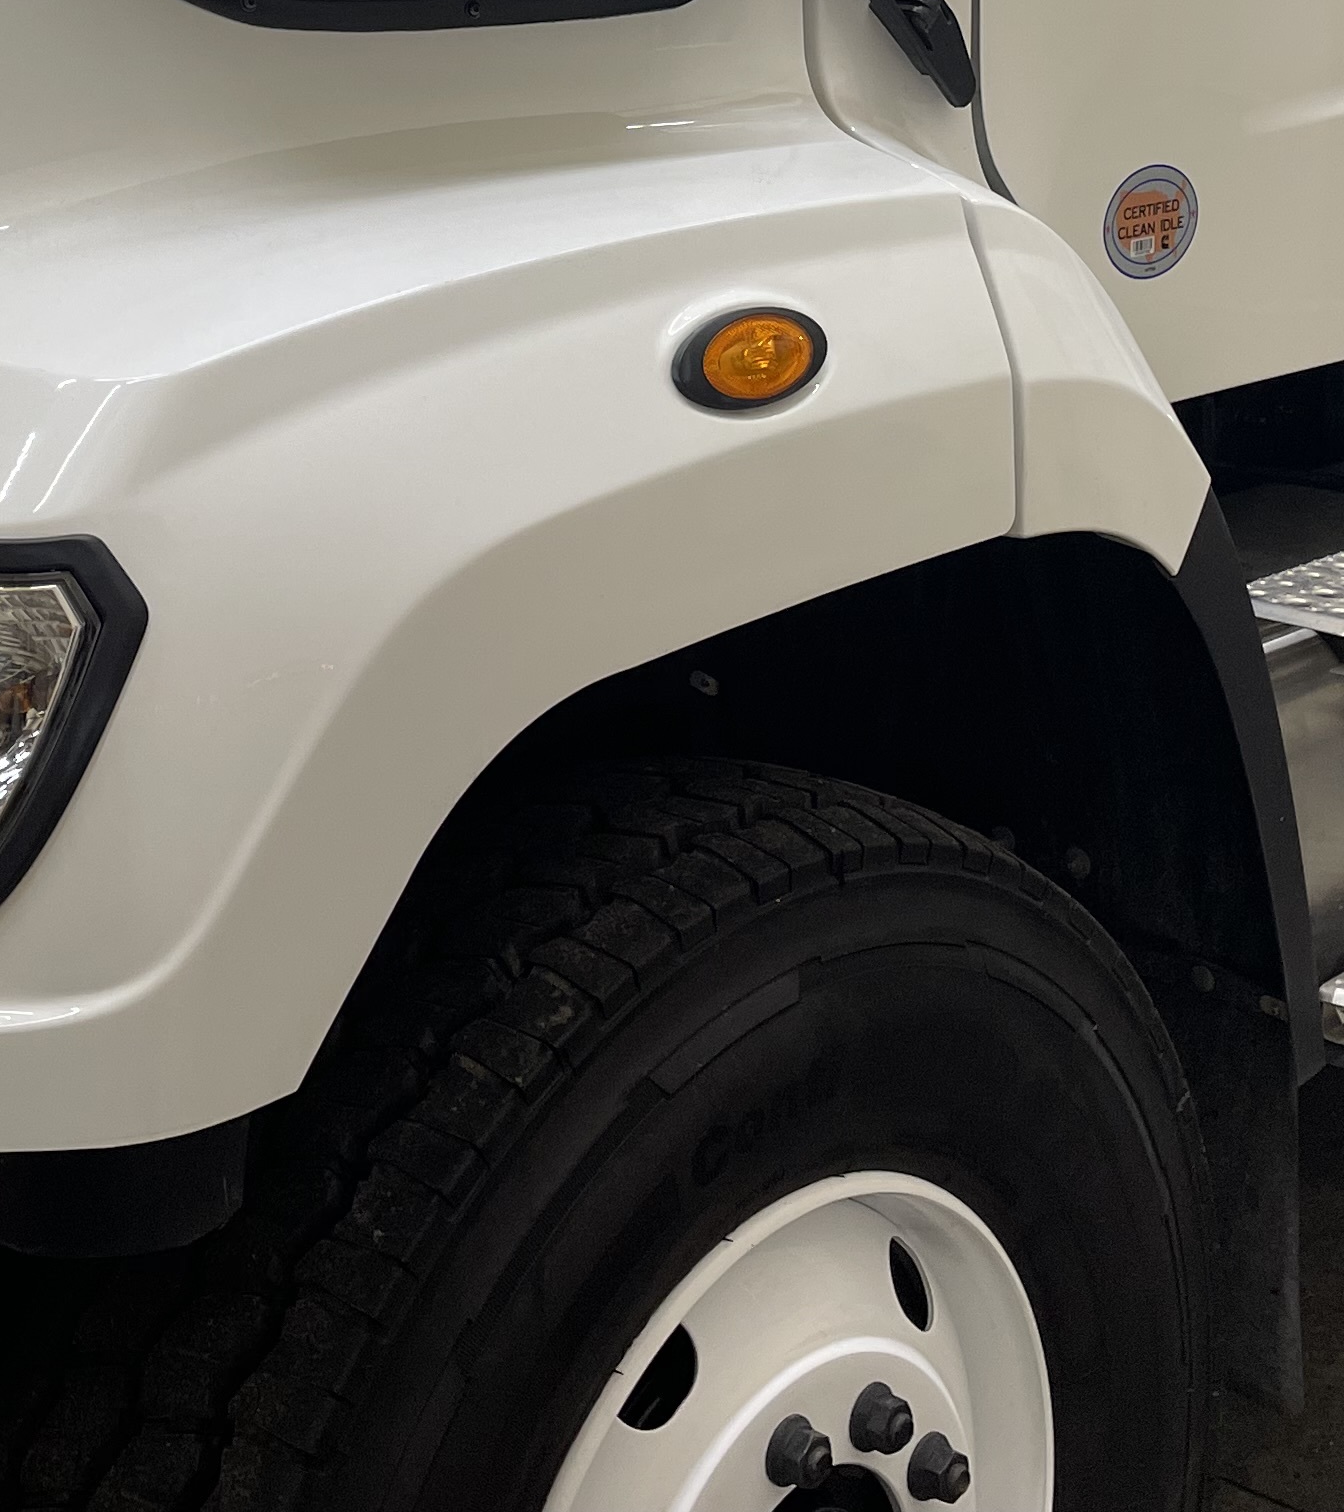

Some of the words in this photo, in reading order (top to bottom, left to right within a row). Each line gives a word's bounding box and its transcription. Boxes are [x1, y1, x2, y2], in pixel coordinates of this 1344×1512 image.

[1123, 199, 1180, 221] CERTIFIED
[1117, 222, 1156, 240] CLEAN
[1160, 216, 1185, 232] IDLE
